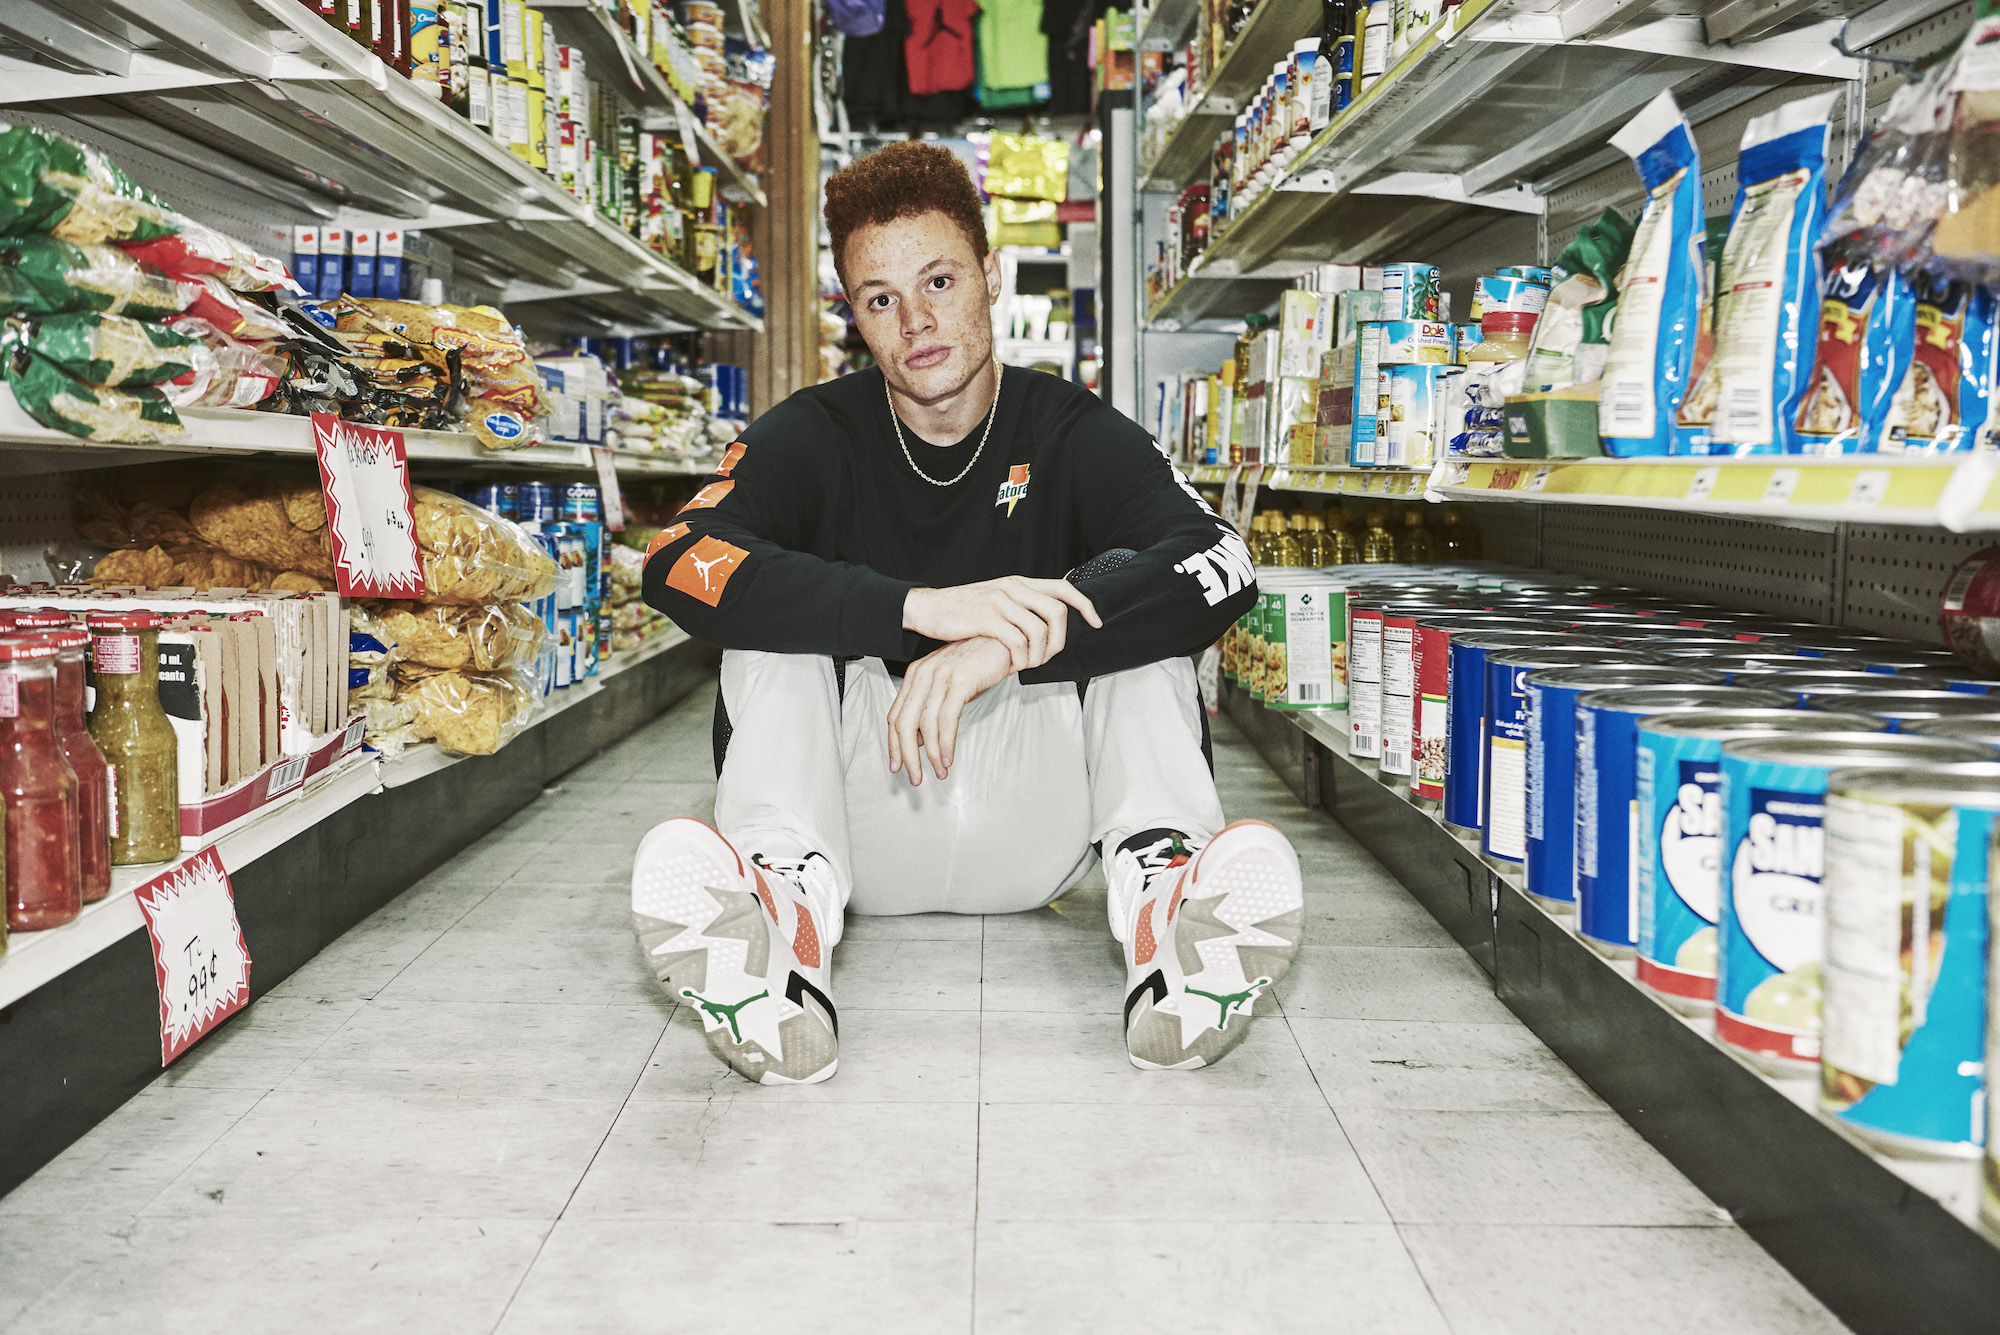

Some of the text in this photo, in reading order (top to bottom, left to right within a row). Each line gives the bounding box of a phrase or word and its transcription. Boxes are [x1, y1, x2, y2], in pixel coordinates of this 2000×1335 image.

[1422, 324, 1445, 336] Dole
[1407, 336, 1431, 344] Crshed
[566, 487, 597, 498] GOYA
[1271, 600, 1282, 610] 48
[159, 670, 185, 682] cante
